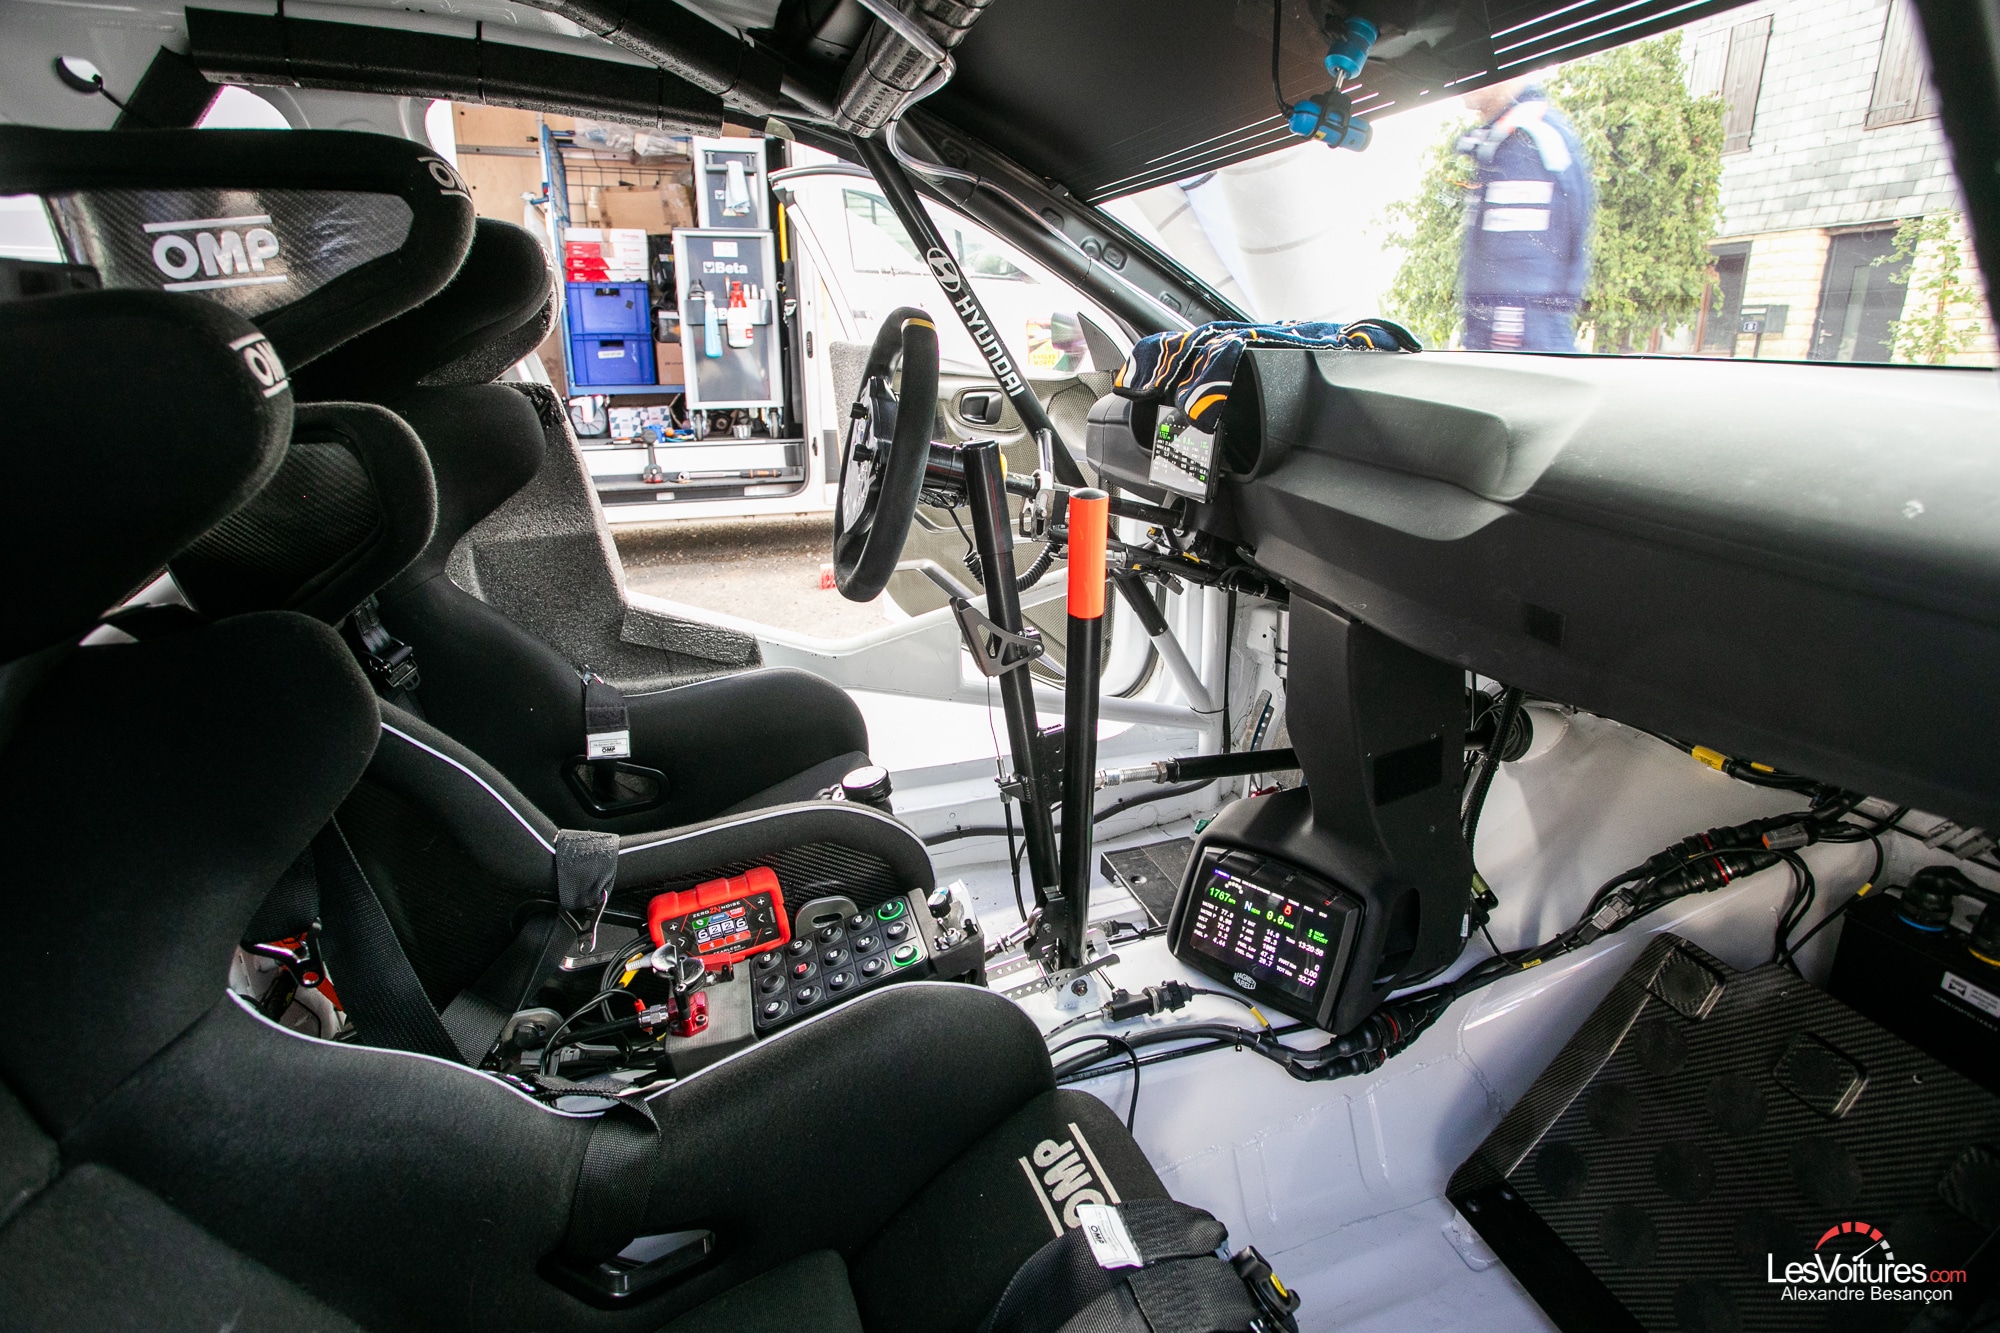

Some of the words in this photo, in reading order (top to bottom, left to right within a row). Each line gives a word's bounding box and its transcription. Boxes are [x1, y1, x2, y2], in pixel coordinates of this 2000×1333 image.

[152, 228, 280, 281] OMP
[714, 261, 748, 275] Beta
[955, 295, 1026, 397] HYUNDAI
[692, 909, 710, 919] ZERO
[709, 906, 722, 914] ZN
[1032, 1138, 1106, 1229] OMP
[1090, 1225, 1105, 1244] OMP
